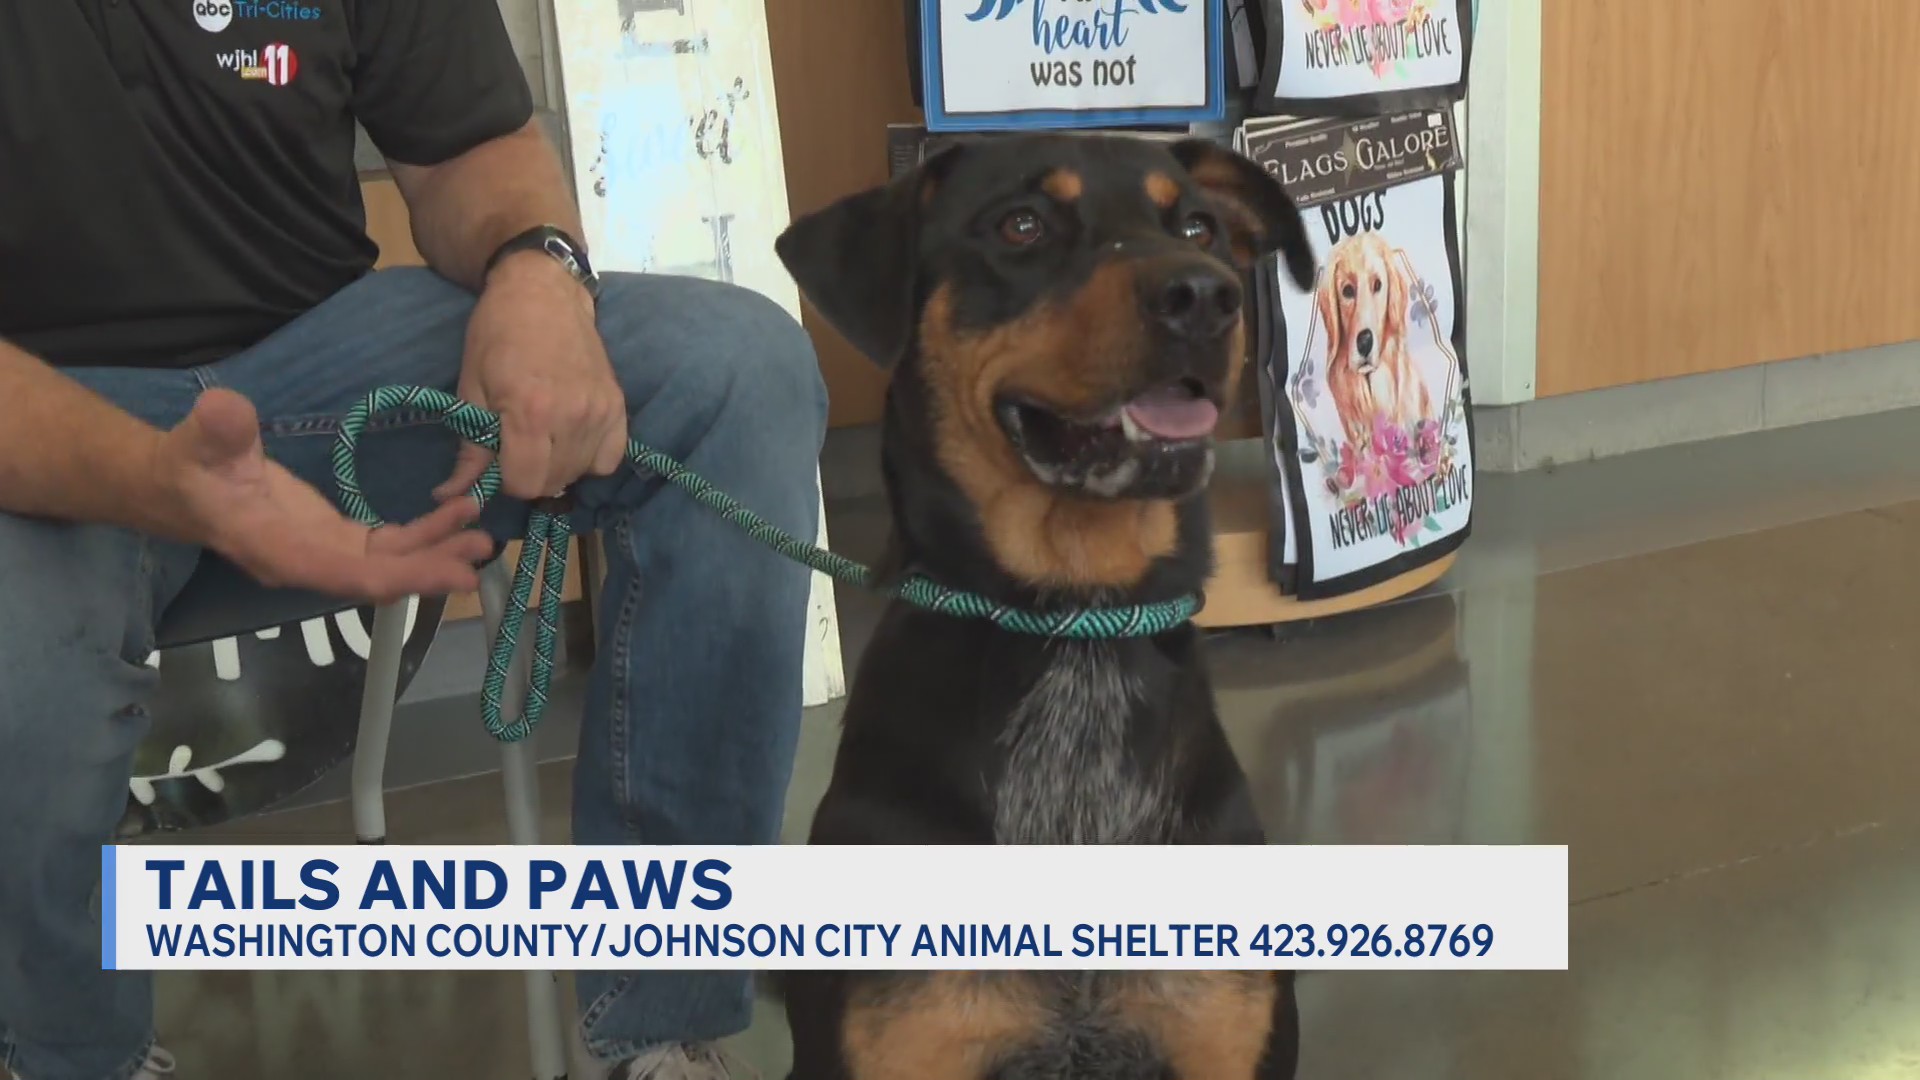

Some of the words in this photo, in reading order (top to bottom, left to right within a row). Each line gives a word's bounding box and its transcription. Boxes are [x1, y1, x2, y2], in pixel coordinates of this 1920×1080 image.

[196, 0, 231, 17] abc
[236, 0, 322, 20] Tri-Cities
[1033, 0, 1140, 55] heart
[216, 49, 257, 72] wjhl
[264, 44, 289, 86] 11
[1030, 61, 1083, 87] was
[1093, 54, 1137, 86] not
[1304, 23, 1348, 70] NEVER
[1349, 24, 1373, 65] LIE
[1412, 17, 1452, 59] LOVE
[1264, 150, 1349, 186] FLAGS
[1355, 125, 1450, 170] GALORE
[1320, 187, 1388, 246] DOGS
[1328, 496, 1373, 550] NEVER
[1374, 492, 1397, 535] LIE
[1395, 473, 1438, 526] ABOUT
[1441, 463, 1469, 510] LOVE
